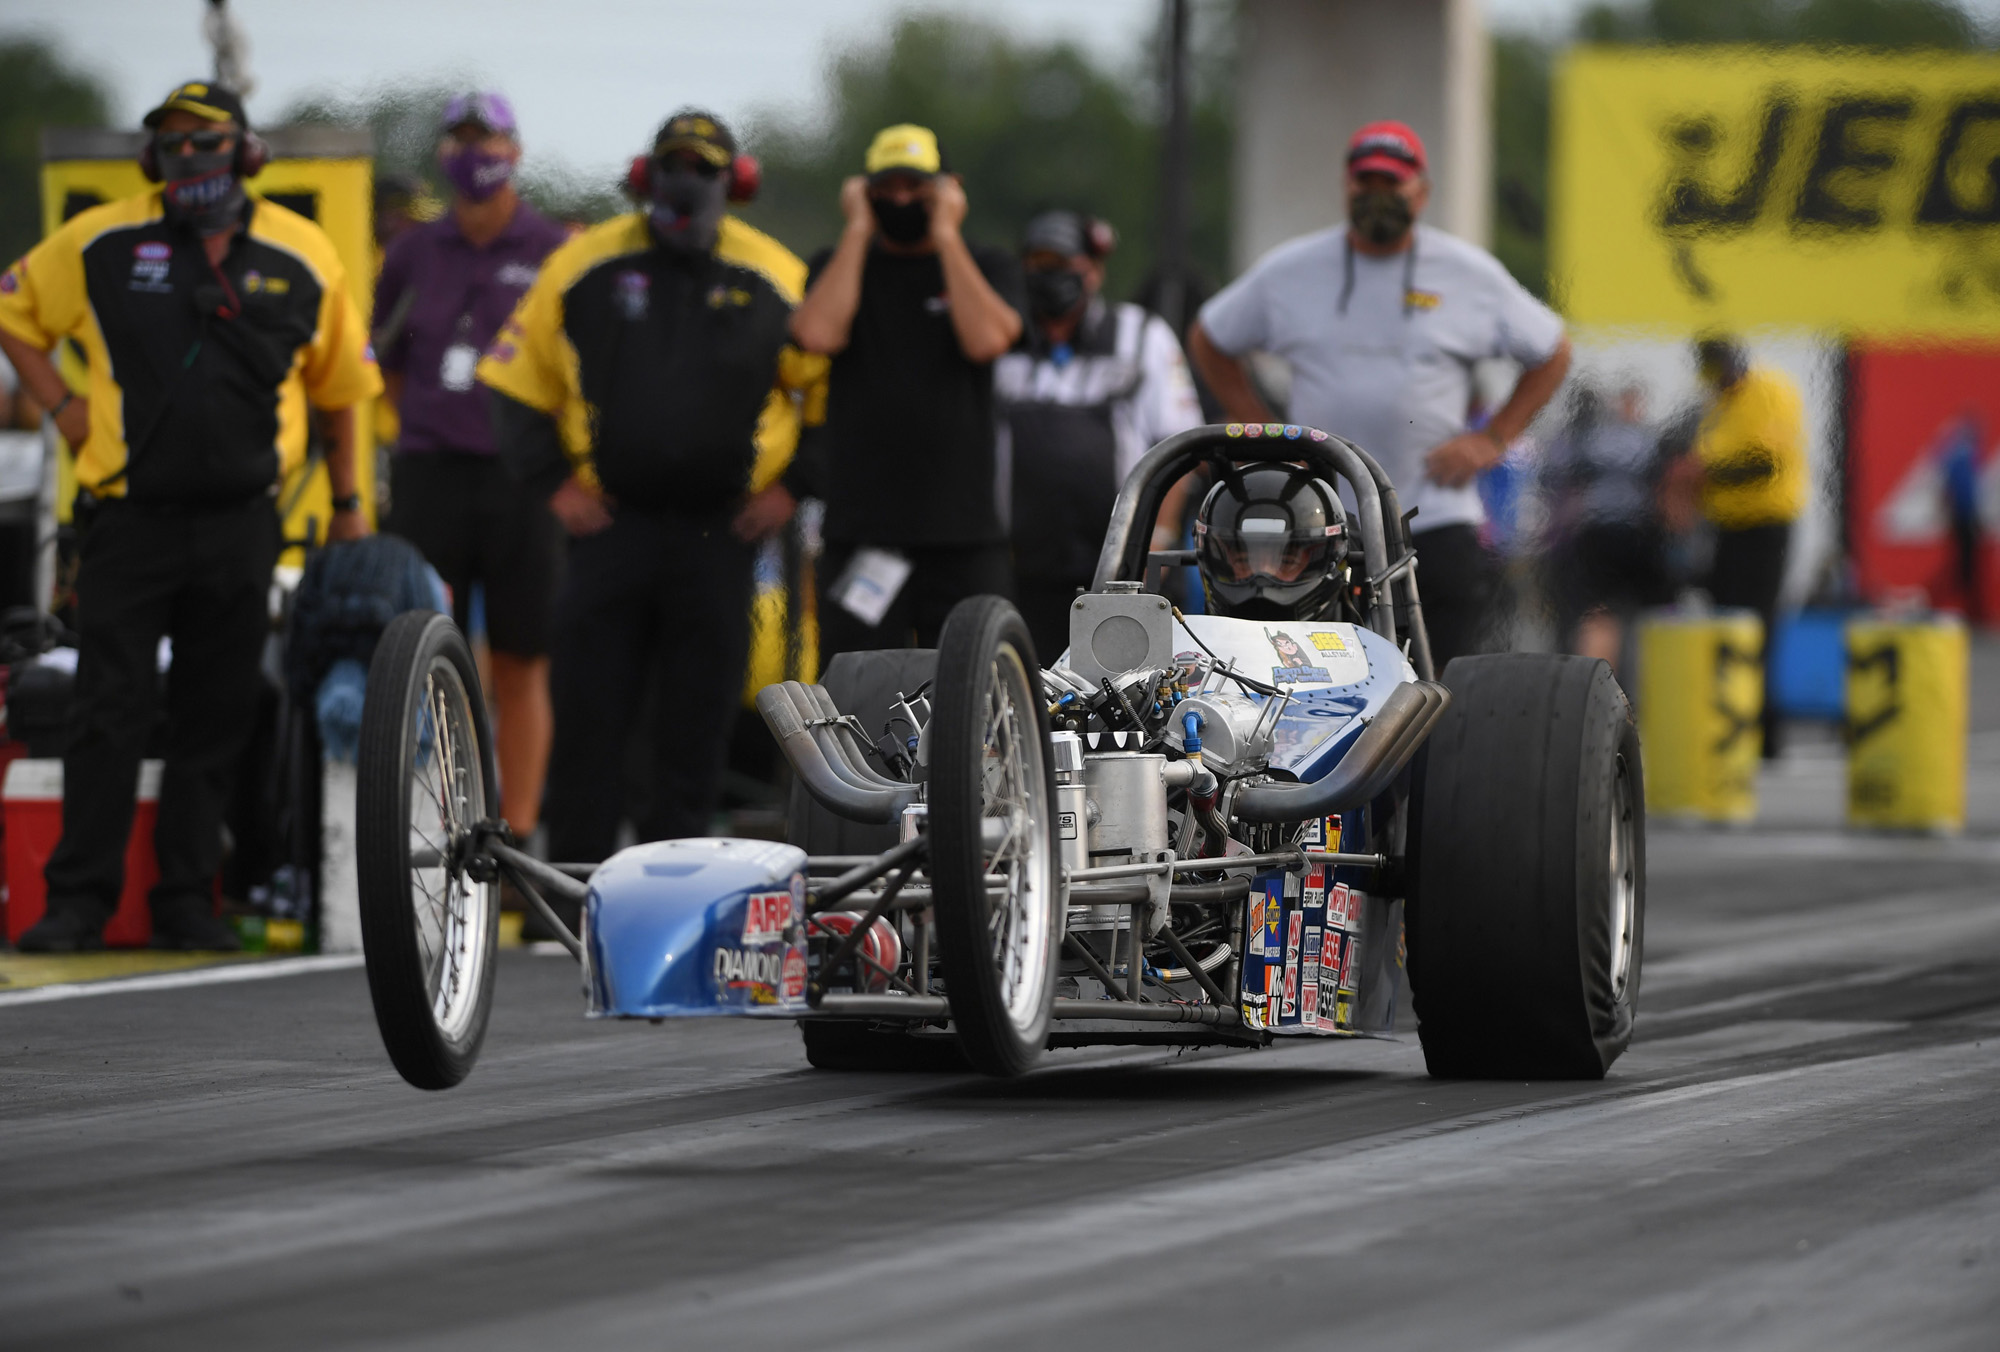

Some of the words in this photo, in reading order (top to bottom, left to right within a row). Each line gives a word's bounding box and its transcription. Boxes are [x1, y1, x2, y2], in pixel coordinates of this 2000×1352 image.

[1306, 631, 1347, 651] JEGS
[746, 895, 792, 934] ARP
[714, 947, 781, 985] DIAMOND
